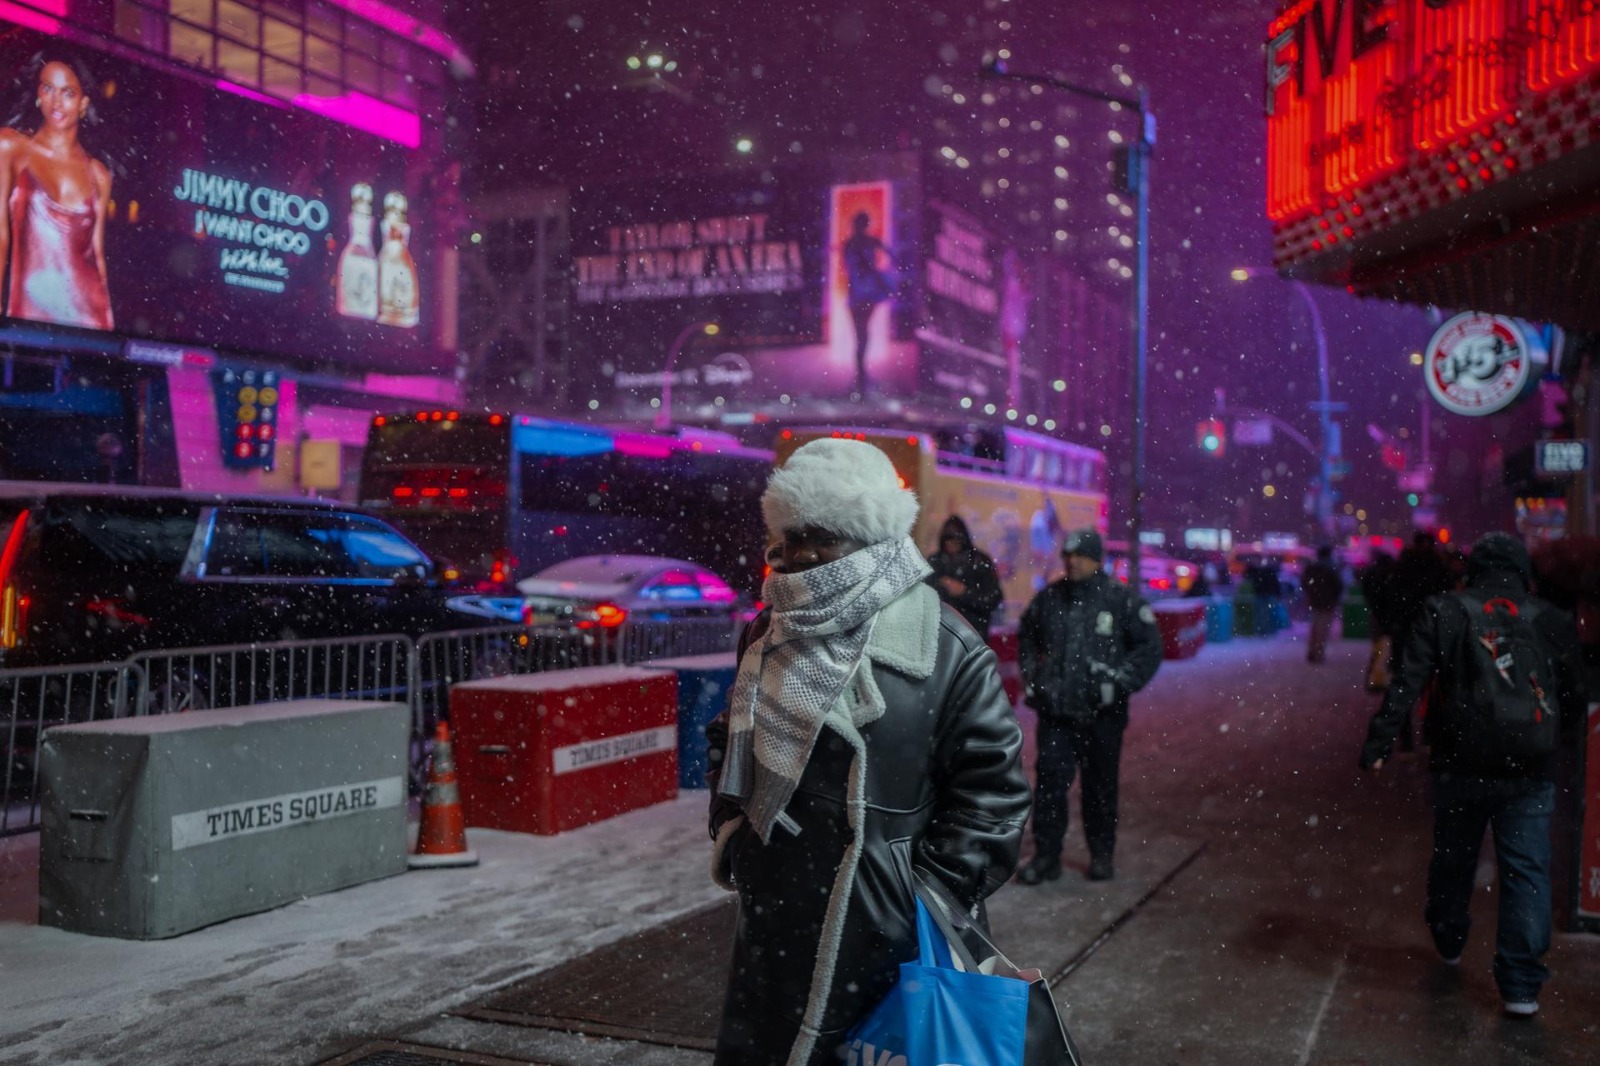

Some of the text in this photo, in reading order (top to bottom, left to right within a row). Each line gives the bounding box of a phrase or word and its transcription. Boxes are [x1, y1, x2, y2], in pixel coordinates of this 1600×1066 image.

[174, 168, 329, 231] JIMMY CHOO
[203, 211, 254, 244] WANT
[252, 223, 311, 255] CHOO
[570, 741, 611, 766] TIMES
[207, 786, 377, 837] TIMES SQUARE
